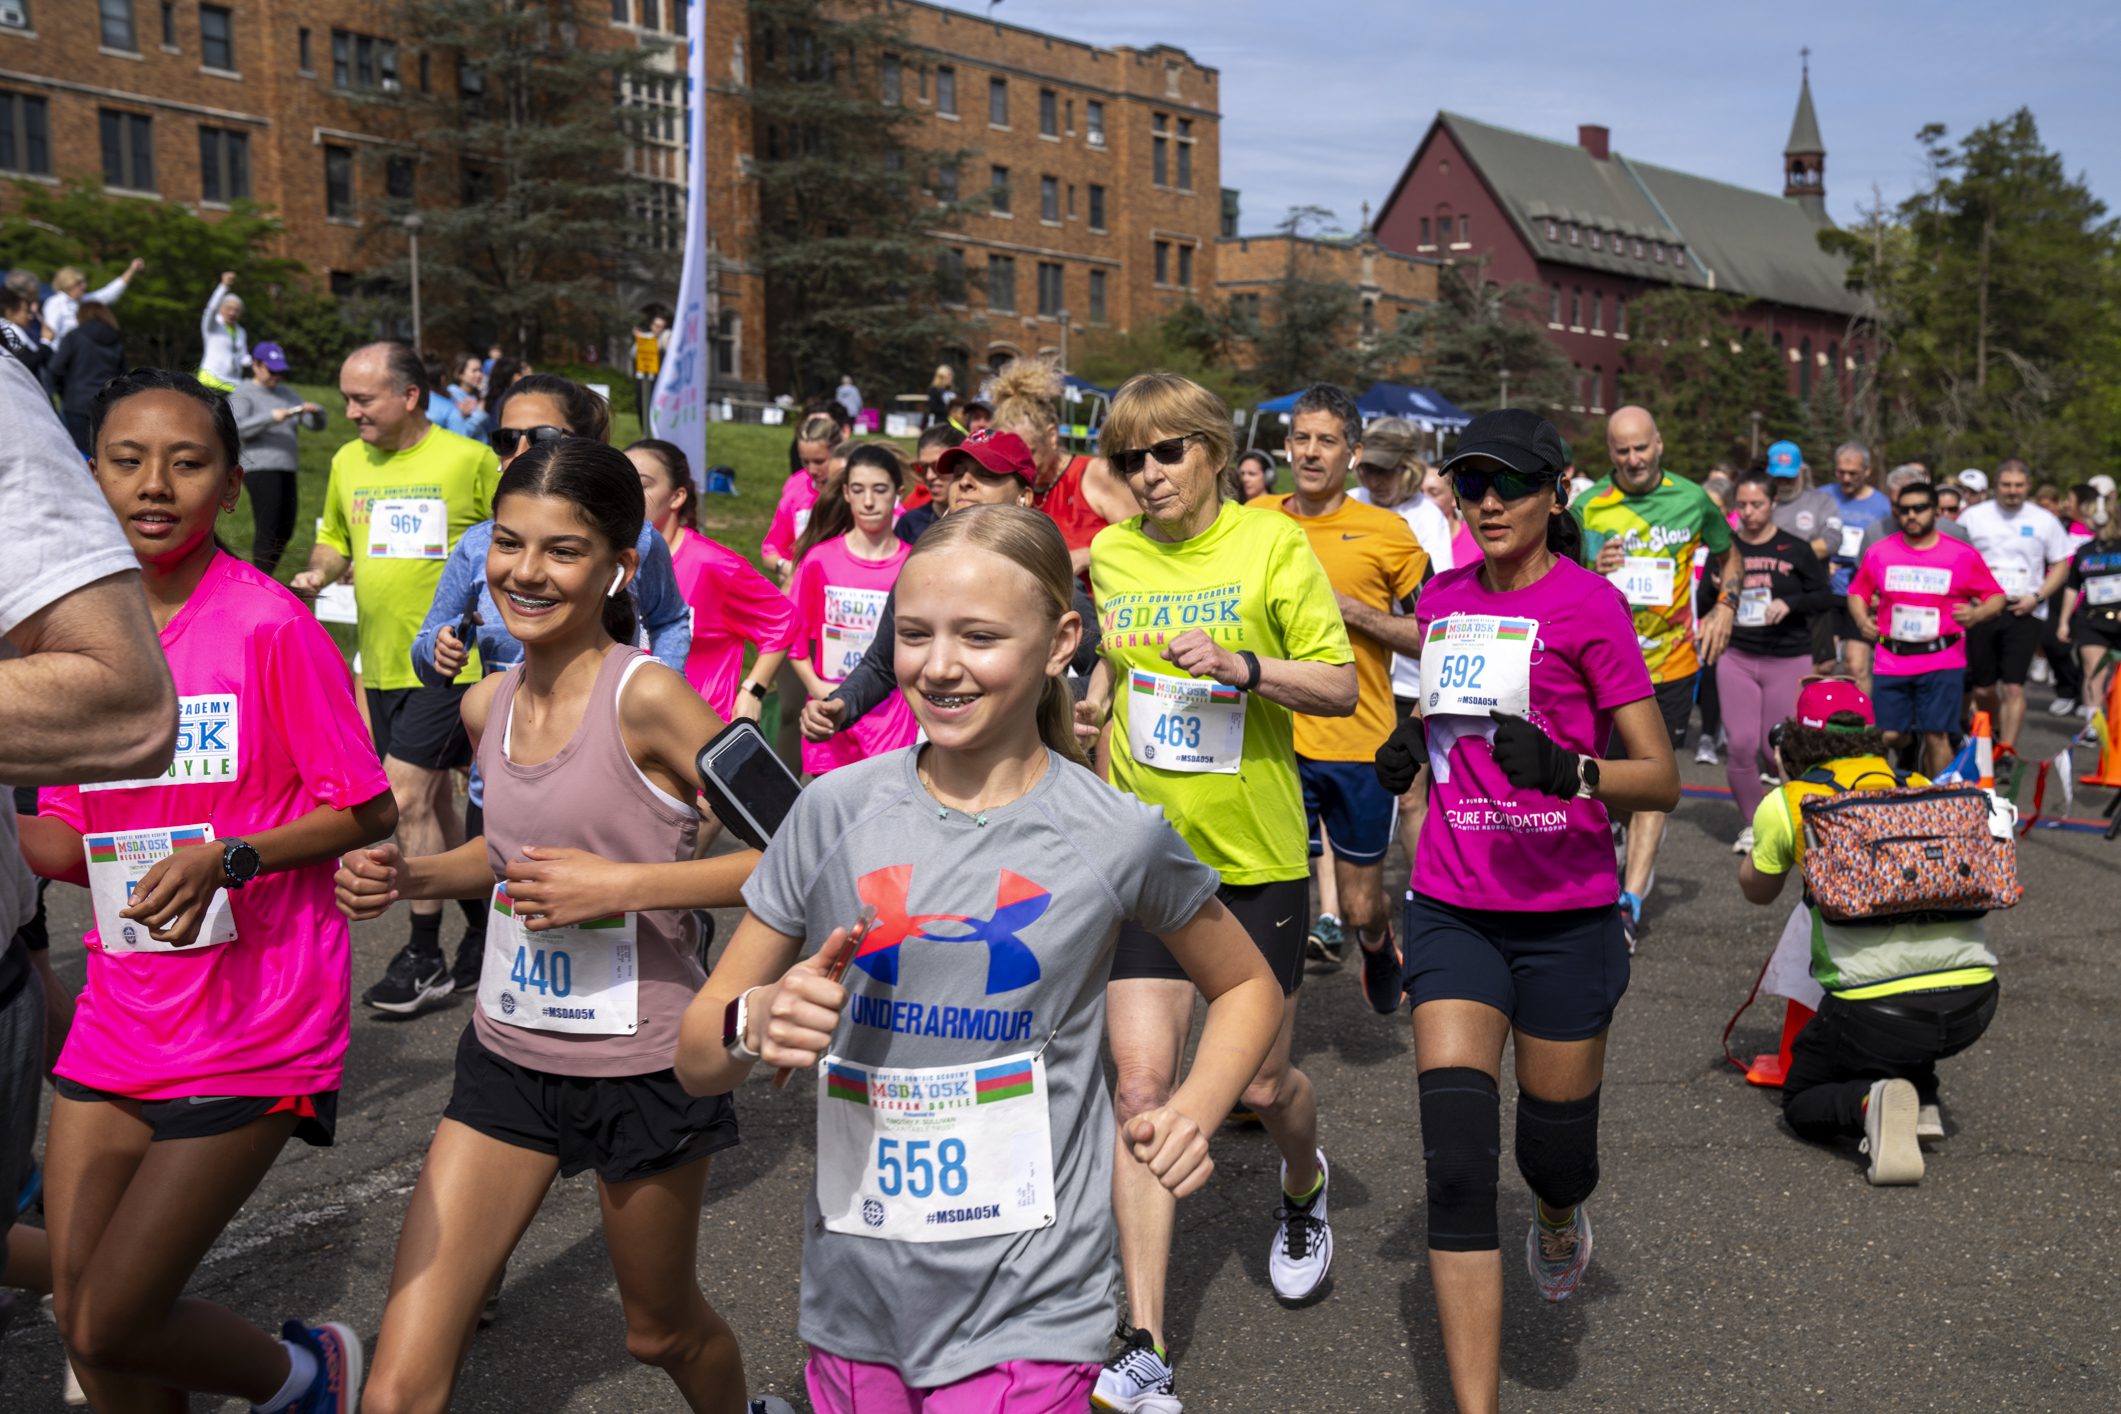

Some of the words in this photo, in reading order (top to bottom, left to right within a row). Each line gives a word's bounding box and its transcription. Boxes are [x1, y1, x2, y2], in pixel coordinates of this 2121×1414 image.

[391, 514, 422, 534] 496
[1649, 525, 1691, 552] Slow
[1626, 576, 1653, 592] 416
[1149, 594, 1193, 603] DOMINIC
[1197, 585, 1241, 600] ACADEMY
[1104, 632, 1164, 650] EGHAN
[1180, 628, 1244, 641] YLE
[1440, 654, 1486, 689] 592
[178, 702, 230, 715] CADEMY
[1457, 696, 1498, 706] #MSDA05K
[176, 719, 230, 753] 5K
[1153, 713, 1201, 748] 463
[168, 758, 230, 777] OYLE
[1176, 754, 1214, 763] #MSDA05K
[1446, 810, 1480, 824] CURE
[511, 946, 571, 998] 440
[542, 1006, 595, 1020] #MSDA05K
[872, 1099, 920, 1111] MEGHAN
[929, 1098, 971, 1111] DOYLE
[878, 1137, 968, 1198] 558
[926, 1204, 1000, 1224] #MSDA05K
